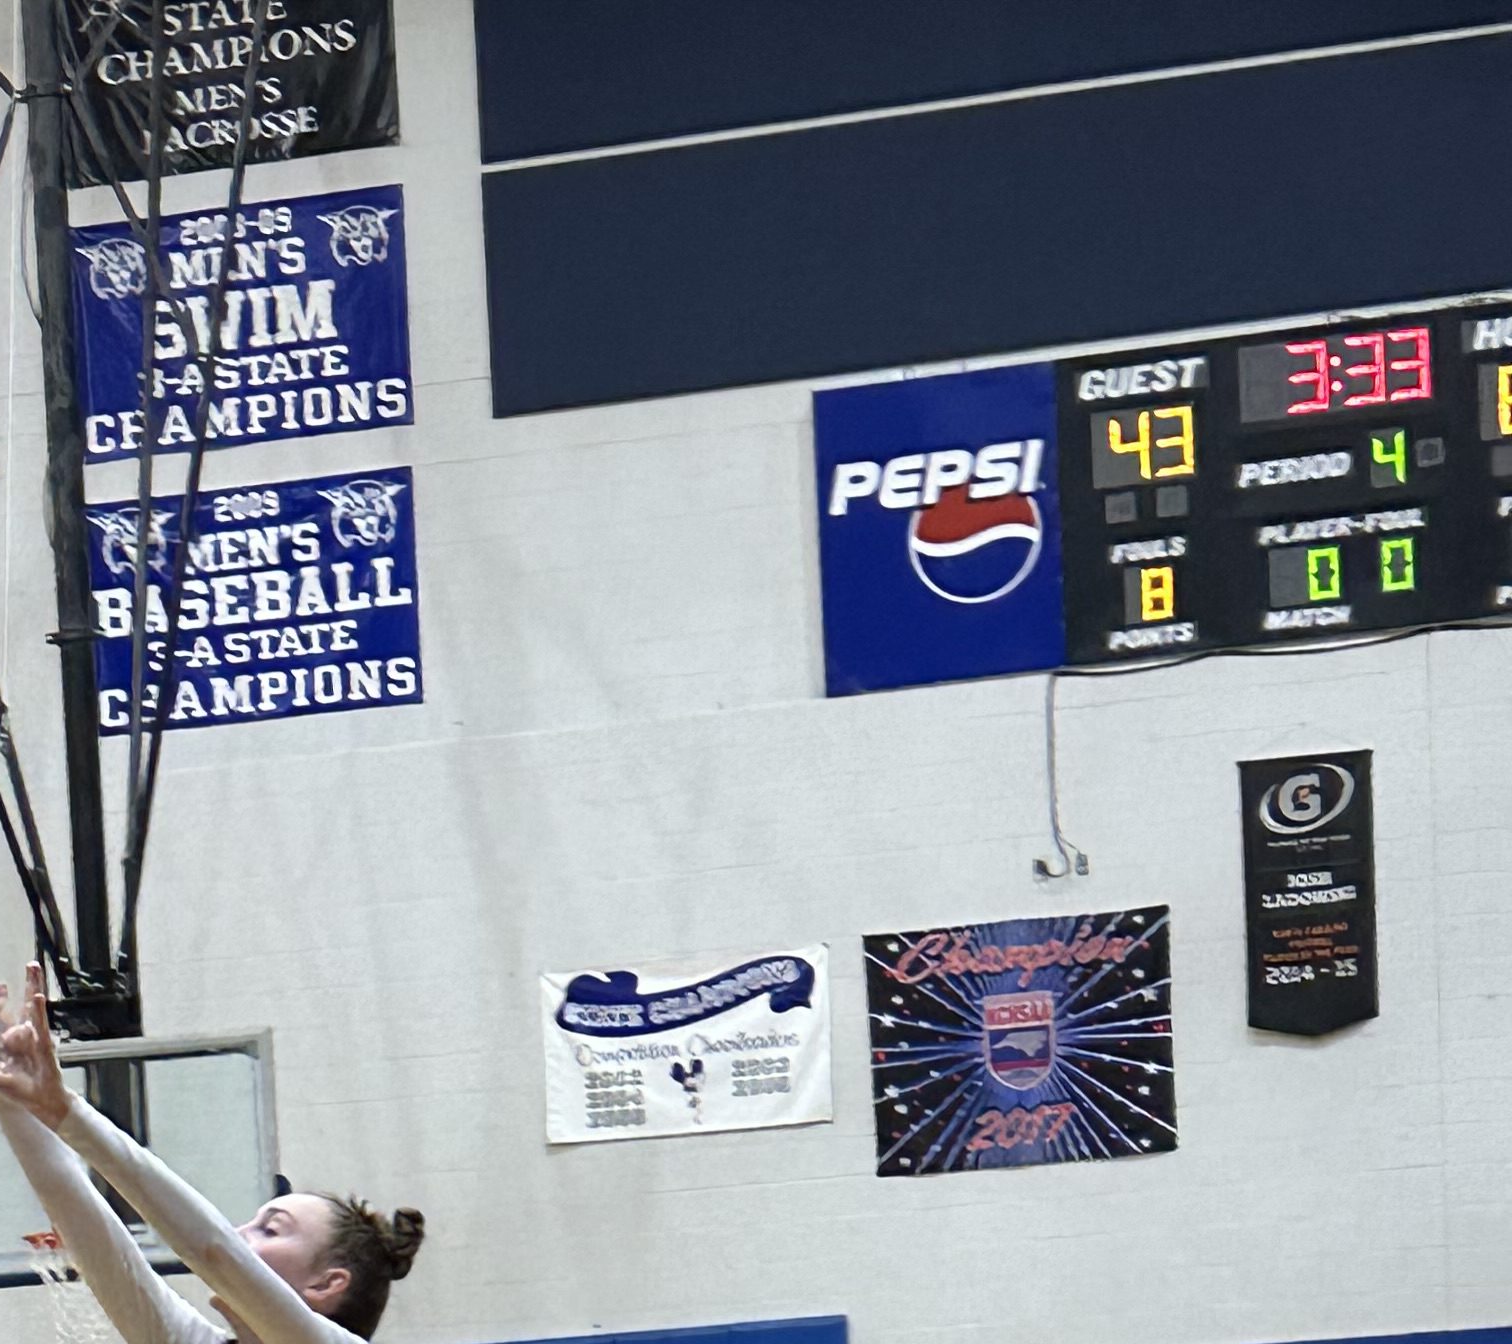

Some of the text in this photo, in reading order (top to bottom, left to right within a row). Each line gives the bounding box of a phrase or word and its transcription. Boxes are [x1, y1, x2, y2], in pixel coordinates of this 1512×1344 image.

[97, 19, 357, 85] CHAMPIONS
[213, 345, 349, 390] STATE
[1078, 357, 1205, 401] GUEST
[1285, 328, 1433, 415] 3:33
[86, 378, 407, 453] CHAMPIONS
[1108, 405, 1195, 480] 43
[829, 439, 1044, 515] PEPSI
[1238, 430, 1407, 489] PERIOD 4
[185, 522, 321, 576] MEN'S
[1307, 537, 1415, 601] 0 0
[91, 557, 413, 638] BASEBALL
[1141, 567, 1174, 622] 8
[223, 620, 359, 664] STATE
[1108, 622, 1195, 650] POINTS
